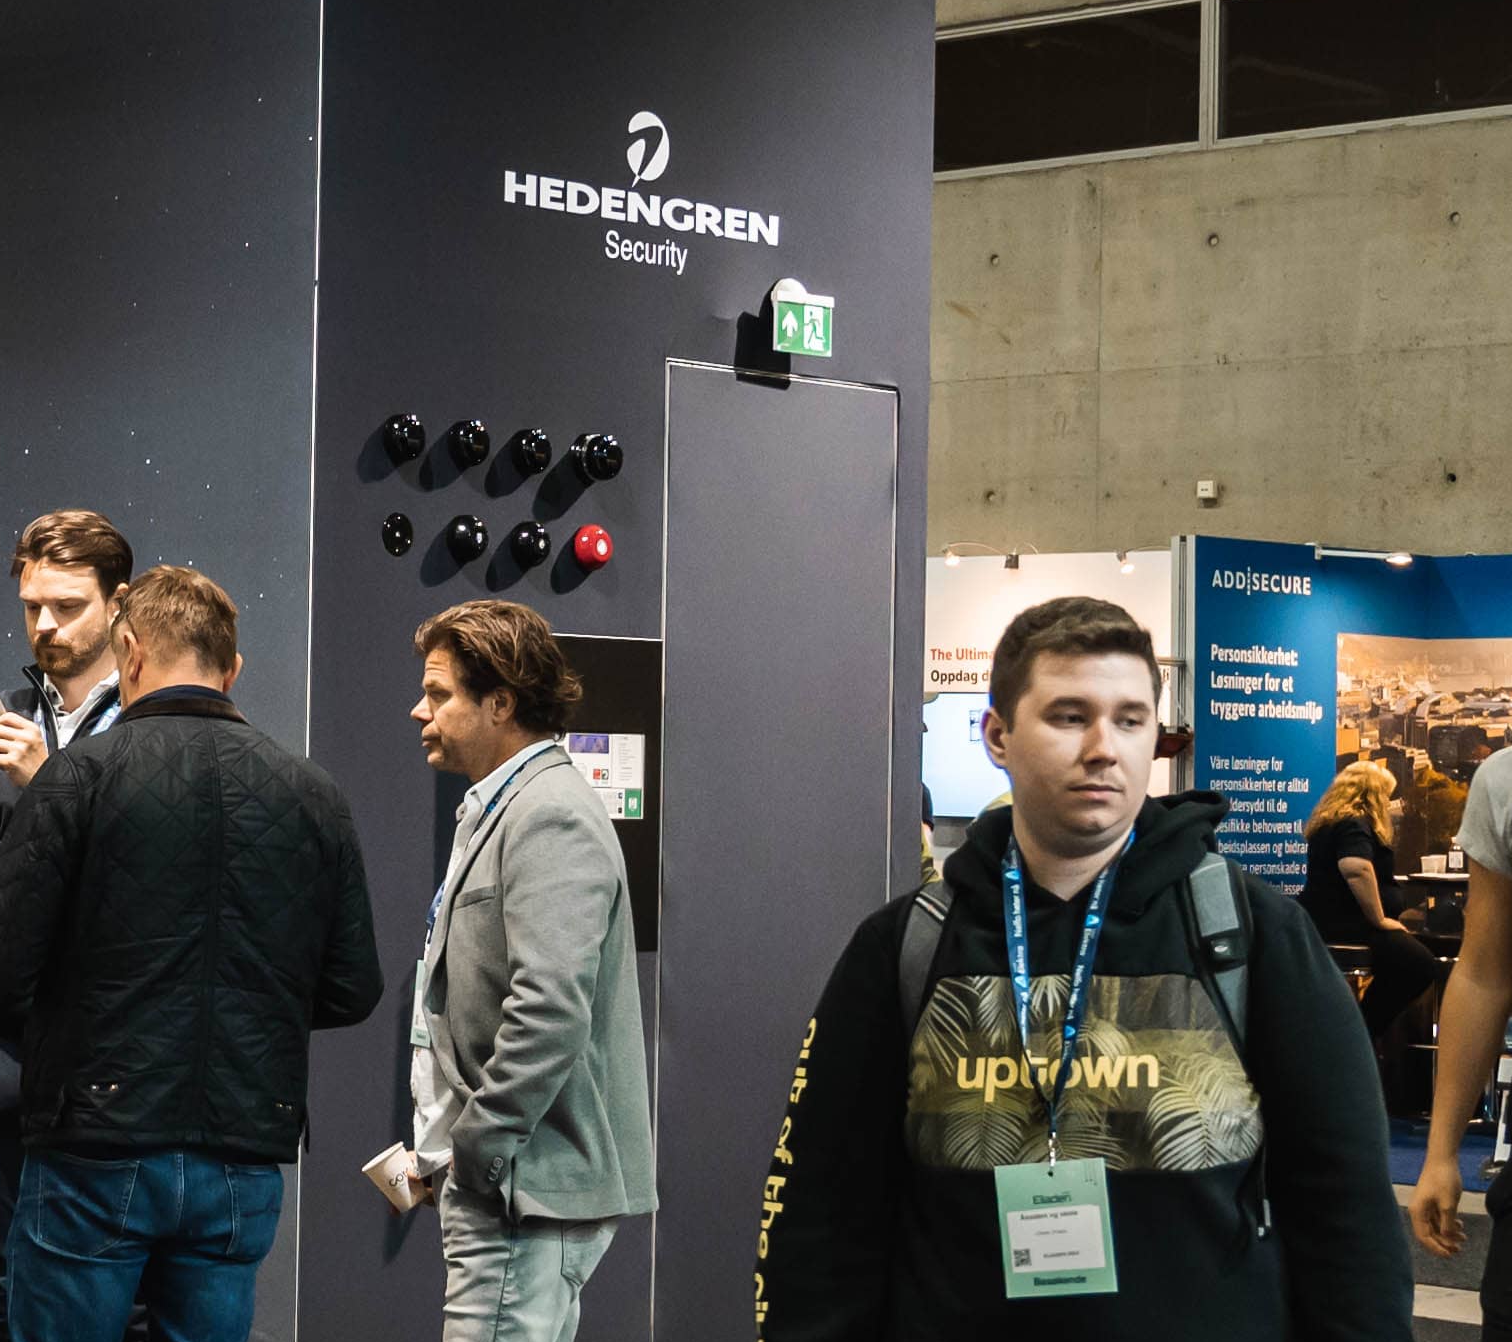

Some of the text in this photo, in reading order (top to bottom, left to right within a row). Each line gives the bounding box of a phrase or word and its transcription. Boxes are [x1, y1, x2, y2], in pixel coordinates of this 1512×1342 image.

[504, 171, 780, 246] HEDENGREN
[605, 230, 689, 275] Security
[930, 648, 952, 661] The
[1210, 643, 1298, 667] Personsikkerhet:
[931, 669, 978, 685] Oppdag
[1210, 671, 1294, 695] Løsninger for et
[1210, 699, 1323, 725] tryggere arbeidsmiljø
[1210, 755, 1284, 775] Våre løsninger for
[1210, 777, 1309, 793] personsikkerhet er alltid
[1266, 799, 1275, 813] til
[1276, 798, 1288, 814] de
[1252, 819, 1292, 834] behovene
[1293, 819, 1303, 834] til
[1218, 840, 1308, 858] beidsplassen og bidrar
